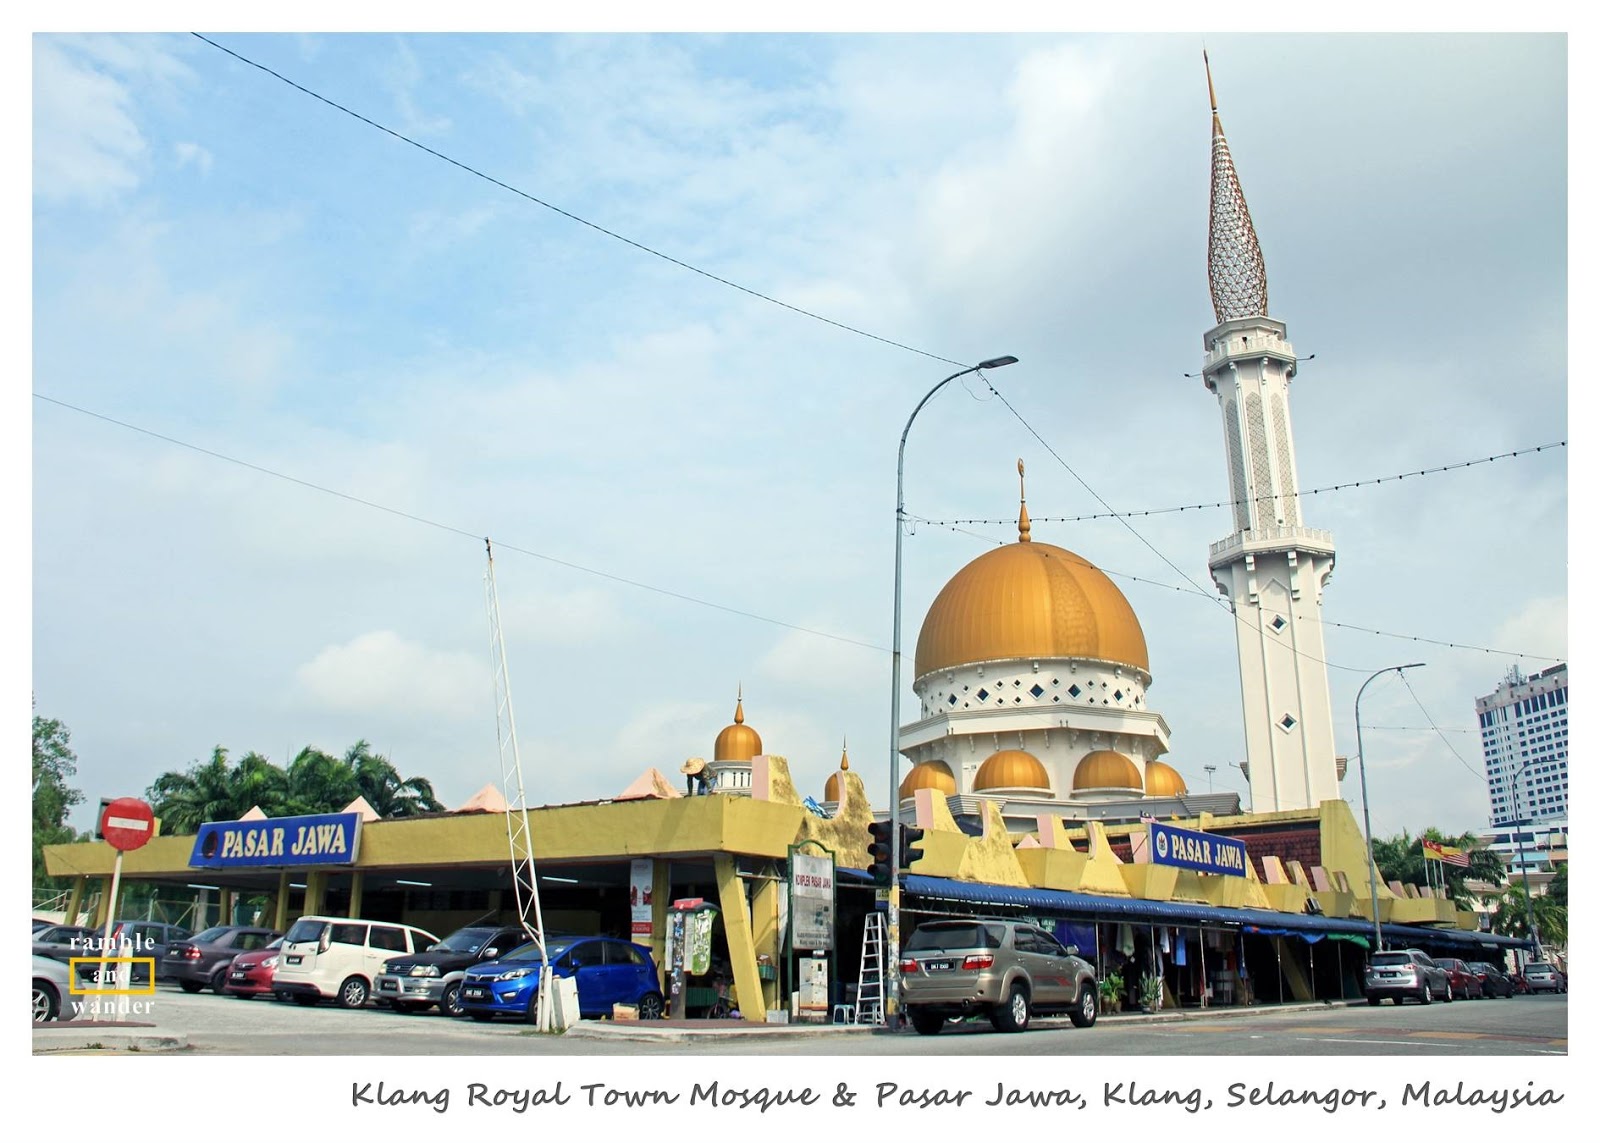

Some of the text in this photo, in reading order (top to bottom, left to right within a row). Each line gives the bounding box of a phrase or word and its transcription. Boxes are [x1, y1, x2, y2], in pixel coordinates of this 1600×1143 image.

[221, 823, 346, 858] PASAR JAWA
[1171, 834, 1243, 870] PASAR JAWA
